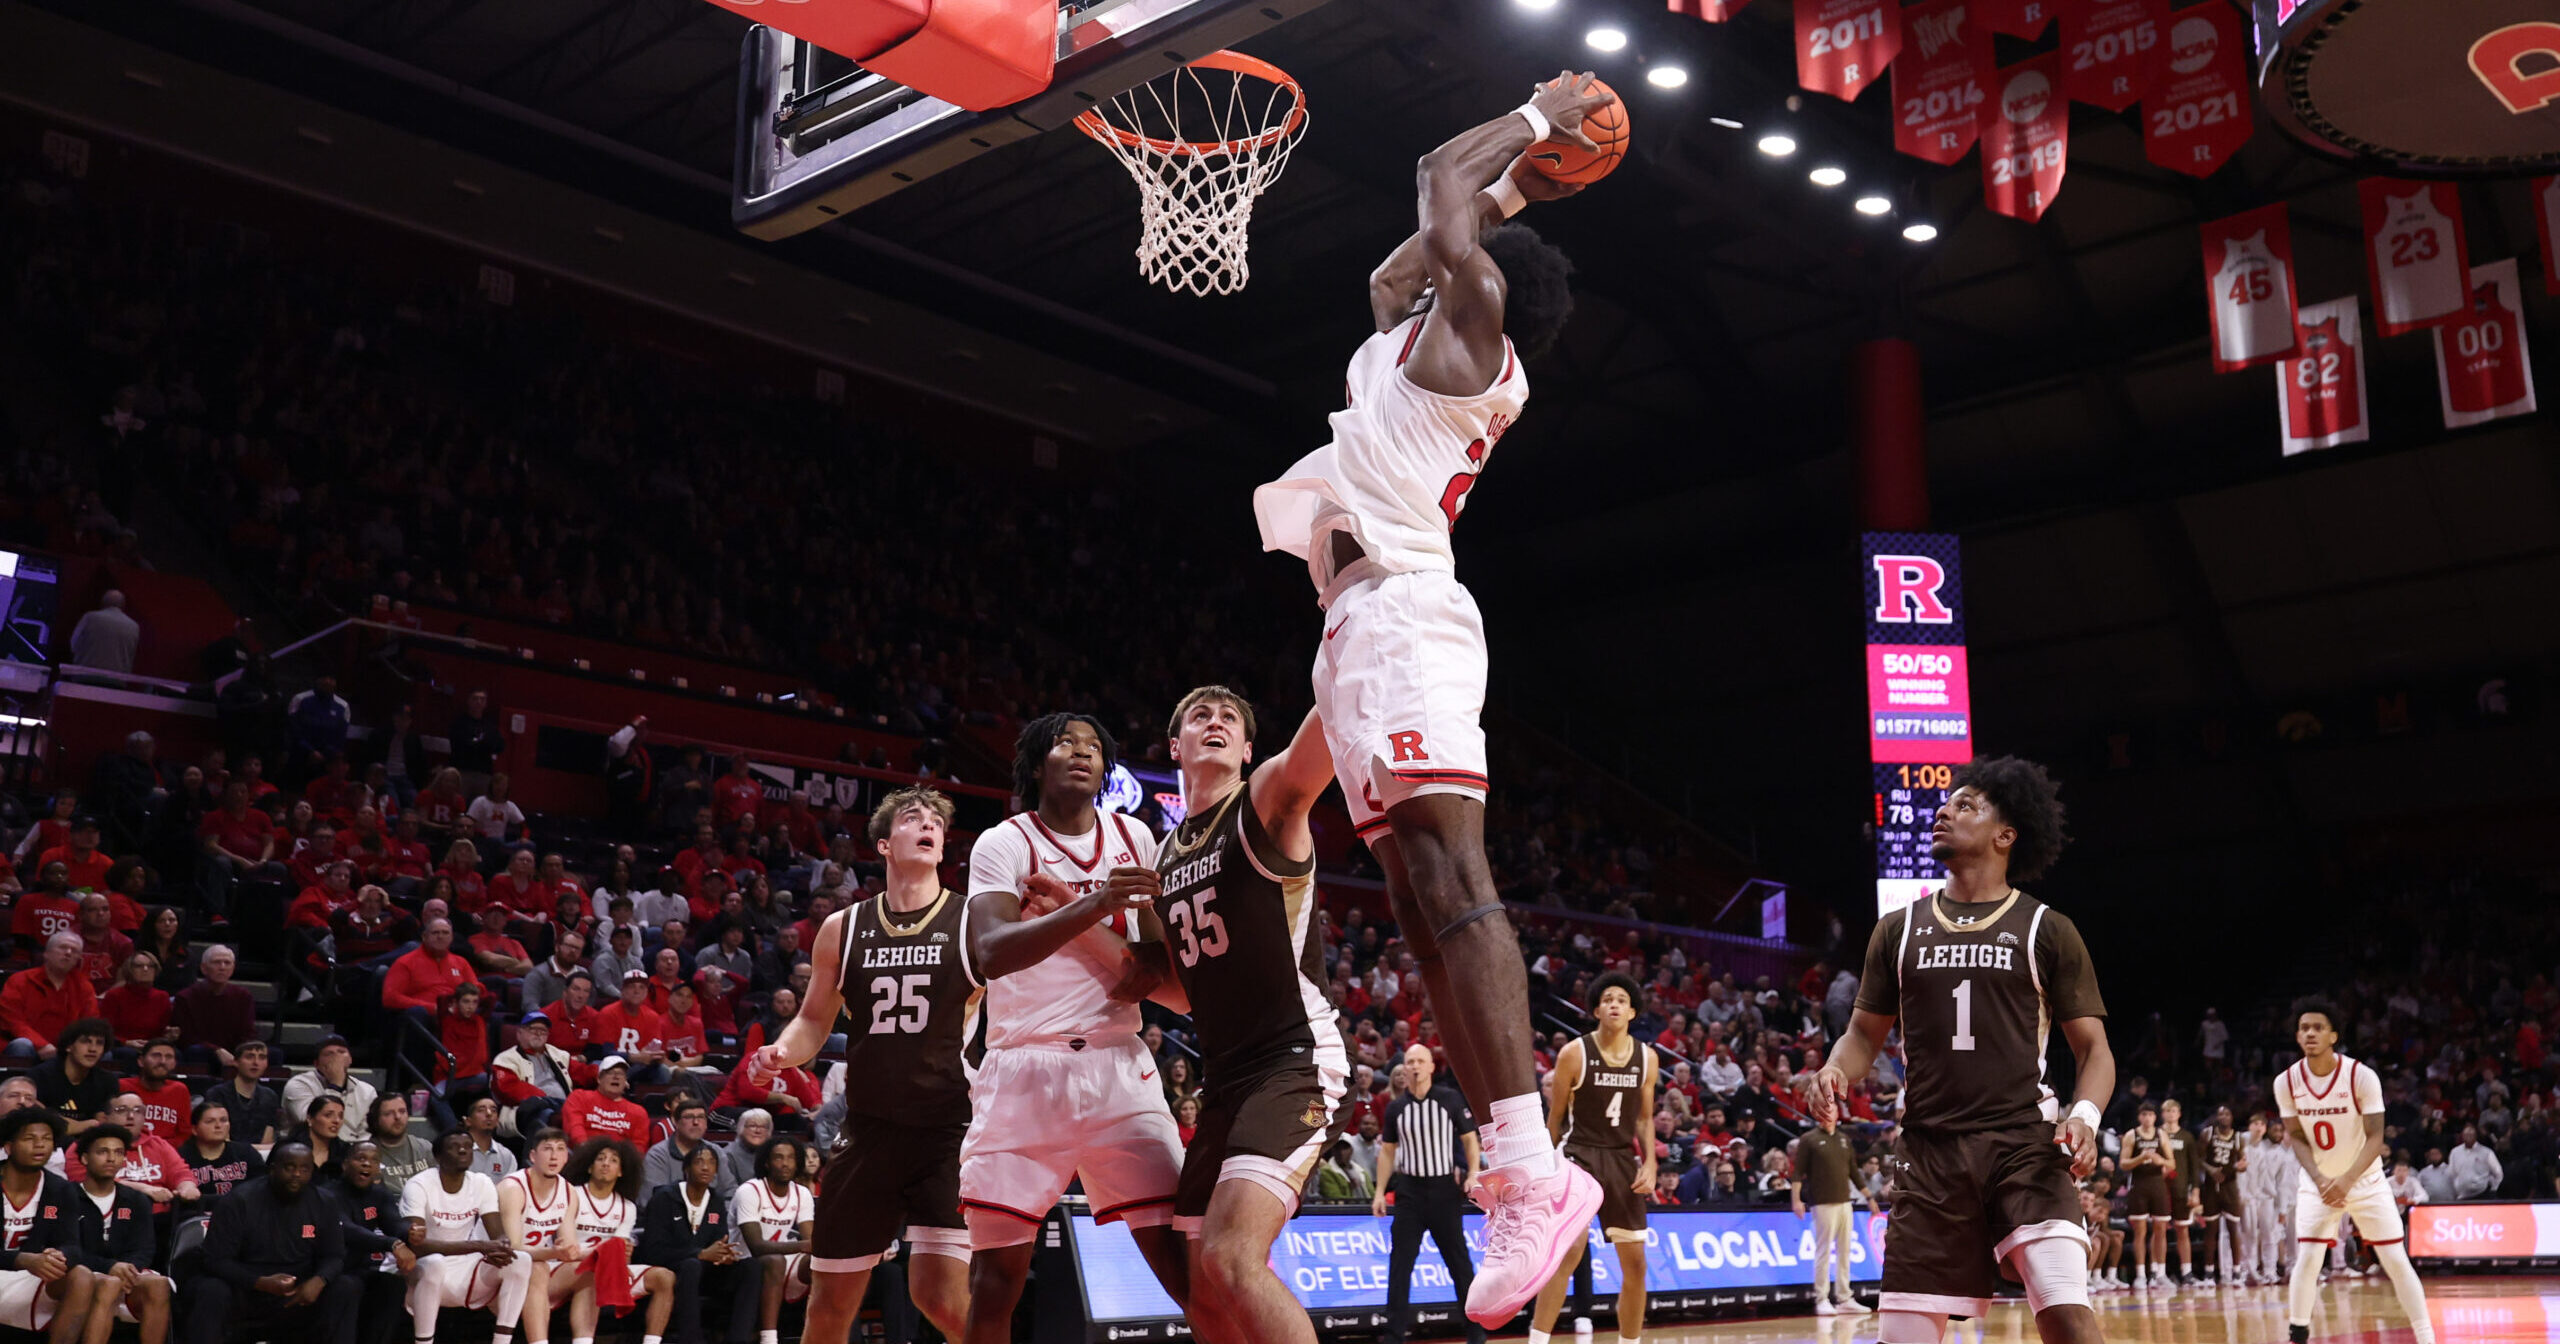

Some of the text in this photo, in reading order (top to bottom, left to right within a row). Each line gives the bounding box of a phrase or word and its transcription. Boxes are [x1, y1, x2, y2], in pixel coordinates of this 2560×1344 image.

[2024, 2, 2042, 24] R
[1809, 7, 1884, 59] 2011
[2071, 19, 2158, 73] 2015
[1843, 63, 1861, 85] R
[2112, 75, 2131, 96] R
[1903, 80, 1985, 127] 2014
[2151, 89, 2239, 138] 2021
[1939, 131, 1960, 150] R
[1991, 138, 2063, 187] 2019
[2192, 144, 2213, 163] R
[2027, 190, 2042, 208] R
[2389, 226, 2440, 268] 23
[2228, 268, 2273, 306] 45
[2457, 320, 2503, 358] 00
[2297, 352, 2341, 389] 82
[1873, 554, 1953, 624] R
[1882, 653, 1953, 675] 50/50
[1886, 678, 1946, 692] WINNING
[1888, 691, 1949, 705] NUMBER:
[1875, 718, 1968, 736] 8157716002
[1387, 729, 1429, 762] R
[1897, 764, 1952, 789] 1:09
[1890, 789, 1912, 802] RU
[434, 804, 451, 824] R
[1888, 804, 1914, 825] 78
[1916, 843, 1933, 853] FG
[1162, 850, 1222, 898] LEHIGH
[40, 916, 70, 937] 99
[1168, 885, 1230, 969] 35
[861, 945, 943, 969] LEHIGH
[1916, 943, 2014, 971] LEHIGH
[868, 973, 931, 1035] 25
[1951, 979, 1976, 1051] 1
[616, 1026, 641, 1055] R
[1593, 1072, 1638, 1088] LEHIGH
[145, 1103, 178, 1125] GERS
[593, 1105, 626, 1119] FAMILY
[1605, 1091, 1623, 1127] 4
[2297, 1106, 2348, 1116] RUTGERS
[2313, 1120, 2336, 1151] 0
[493, 1163, 502, 1173] R
[214, 1181, 233, 1196] R
[44, 1205, 58, 1220] R
[117, 1207, 132, 1221] R
[363, 1206, 378, 1221] R
[432, 1207, 480, 1221] RUTGERS
[707, 1212, 720, 1225] R
[301, 1223, 316, 1239] R
[2433, 1216, 2505, 1243] Solve
[1668, 1229, 1798, 1271] LOCAL
[1295, 1266, 1334, 1292] OF
